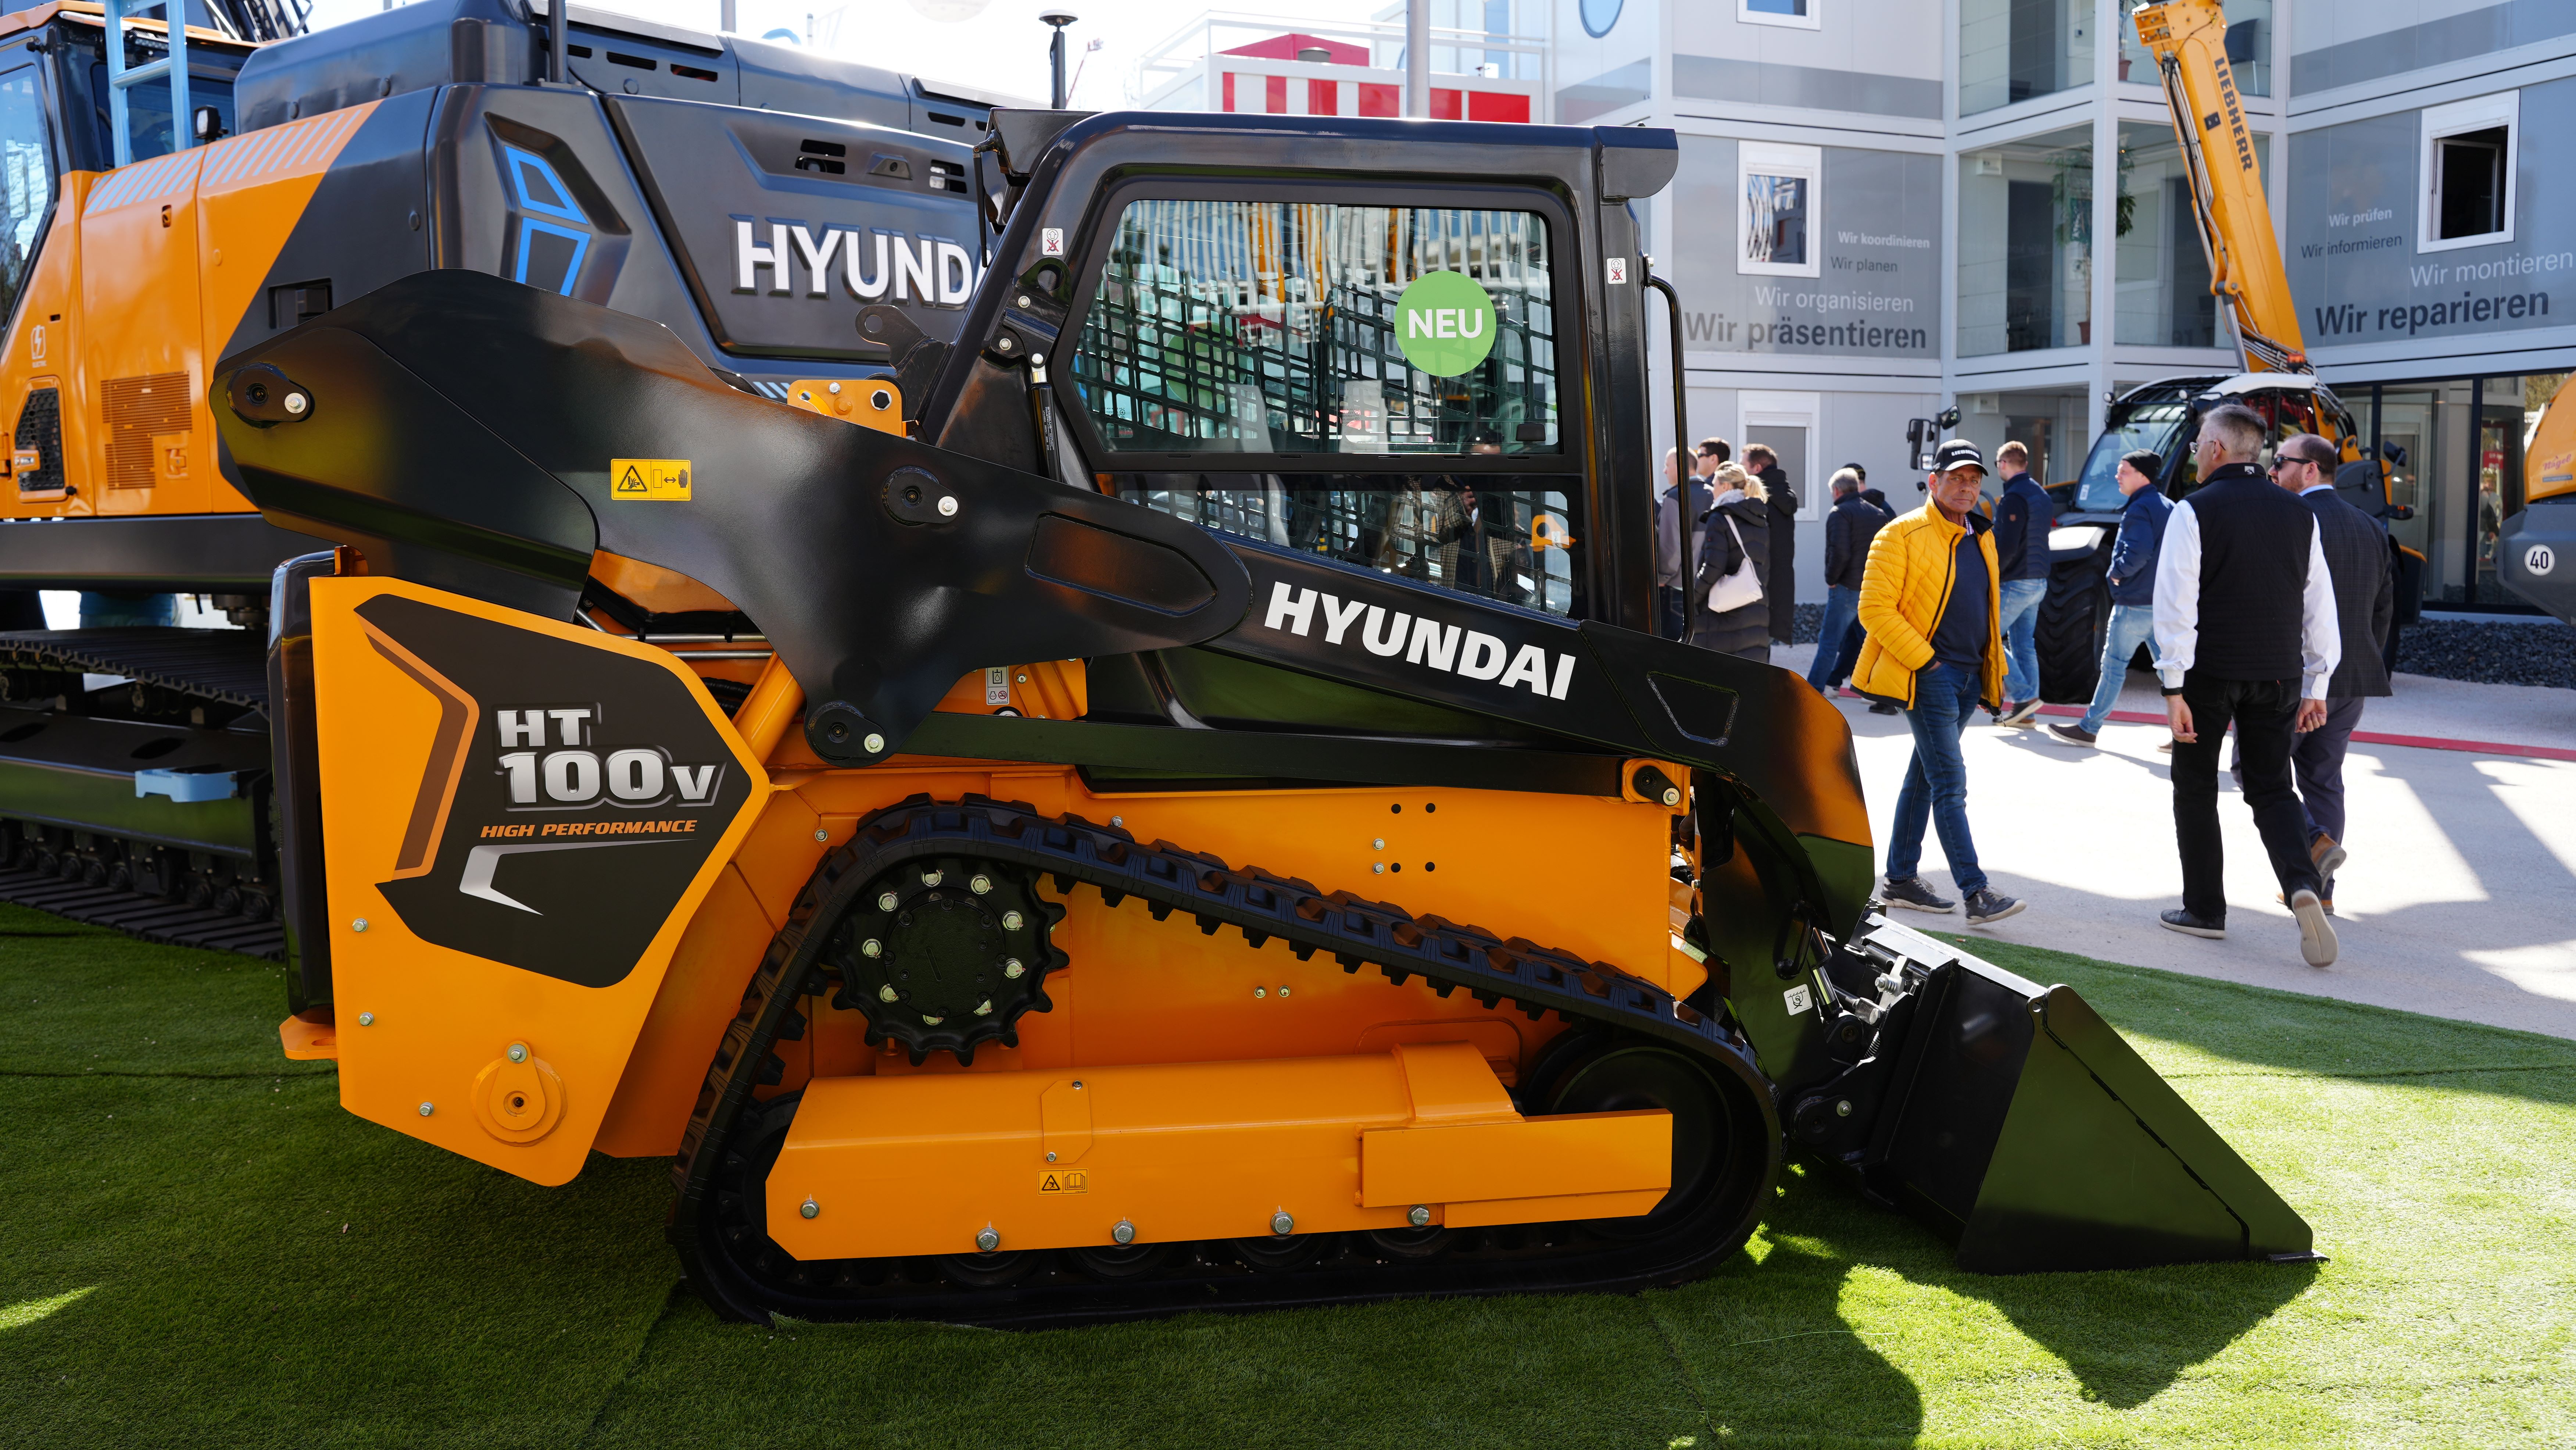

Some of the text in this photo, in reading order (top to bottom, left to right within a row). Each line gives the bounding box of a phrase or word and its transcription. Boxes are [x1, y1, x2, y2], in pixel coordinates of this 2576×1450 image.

[2214, 57, 2253, 172] LIEBHERR
[2329, 208, 2392, 228] Wir prüfen
[1838, 231, 1929, 248] Wir koordinieren
[2301, 234, 2402, 258] Wir informieren
[1831, 256, 1898, 274] Wir planen
[2411, 251, 2573, 288] Wir montieren
[1755, 286, 1914, 313] Wir organisieren
[2316, 291, 2548, 336] Wir reparieren
[1408, 308, 1482, 338] NEU
[1685, 312, 1926, 350] Wir präsentieren
[2530, 551, 2549, 569] 40
[1264, 581, 1576, 701] HYUNDAI
[498, 710, 591, 747] HT
[480, 820, 697, 838] HIGH PERFORMANCE
